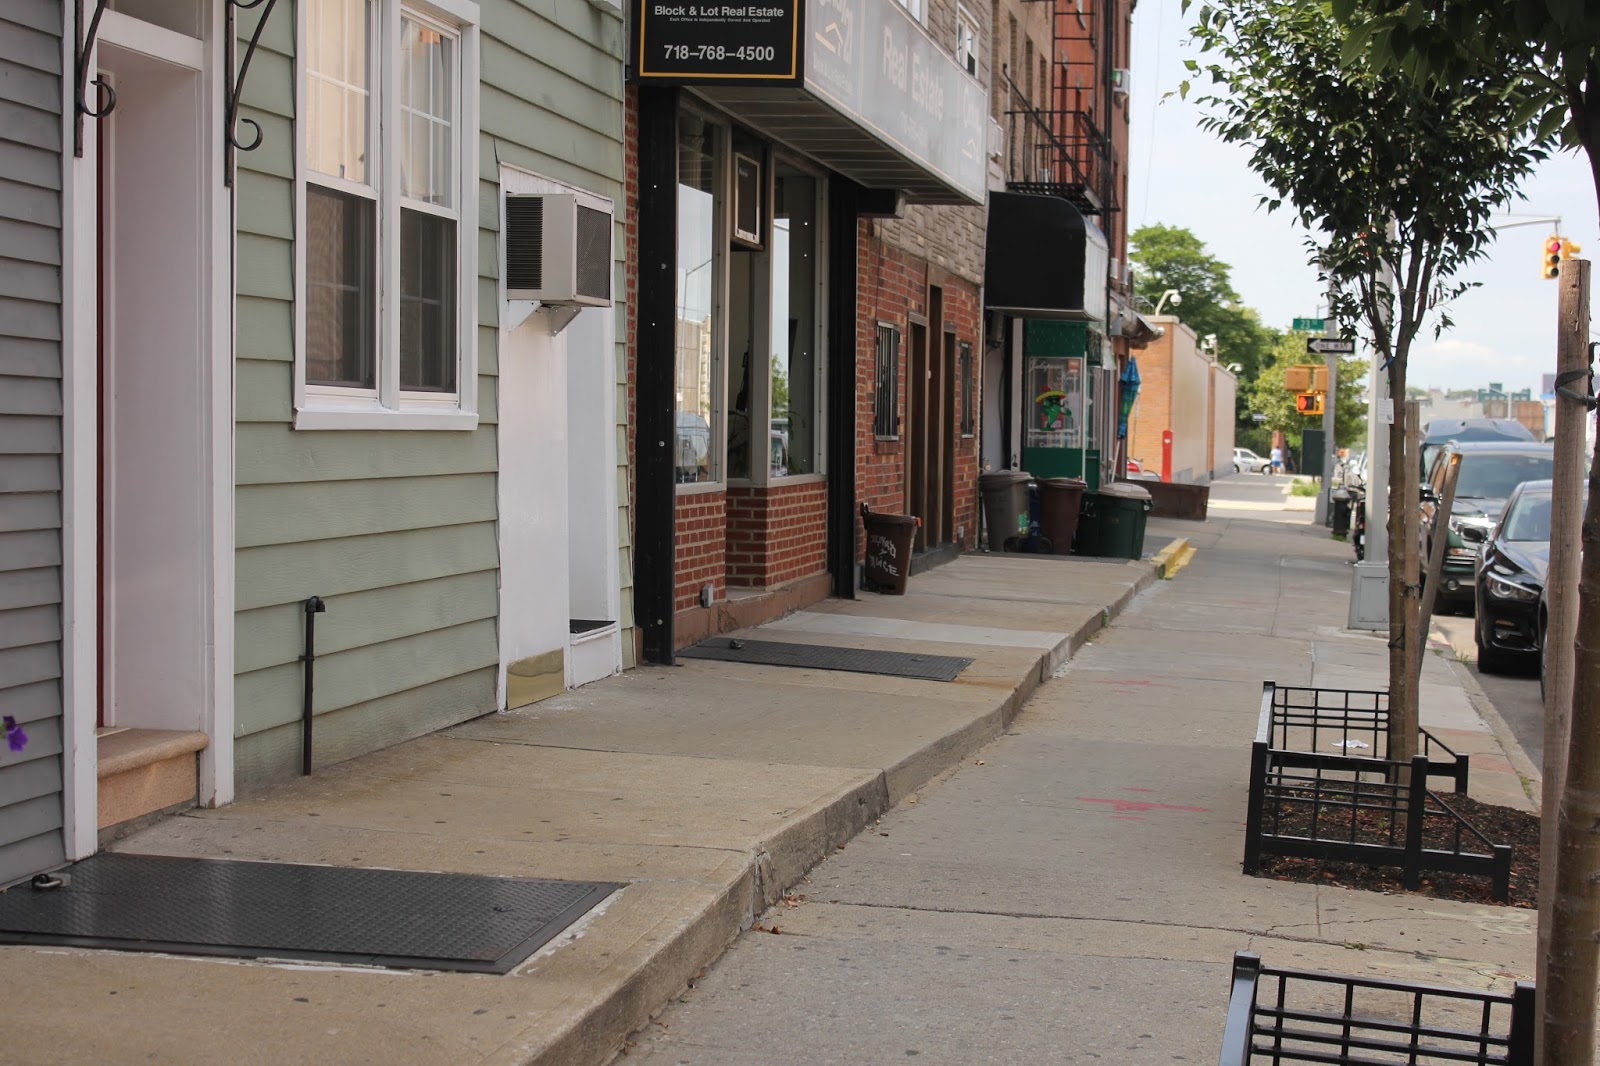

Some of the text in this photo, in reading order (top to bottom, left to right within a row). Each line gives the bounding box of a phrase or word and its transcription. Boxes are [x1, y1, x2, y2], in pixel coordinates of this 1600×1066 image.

[654, 6, 785, 17] Block & Lot Real Estate
[663, 44, 775, 61] 718-768-4500
[883, 24, 909, 94] Real
[911, 51, 945, 123] Estate
[1300, 320, 1310, 330] 23
[1315, 342, 1349, 350] ONE WAY
